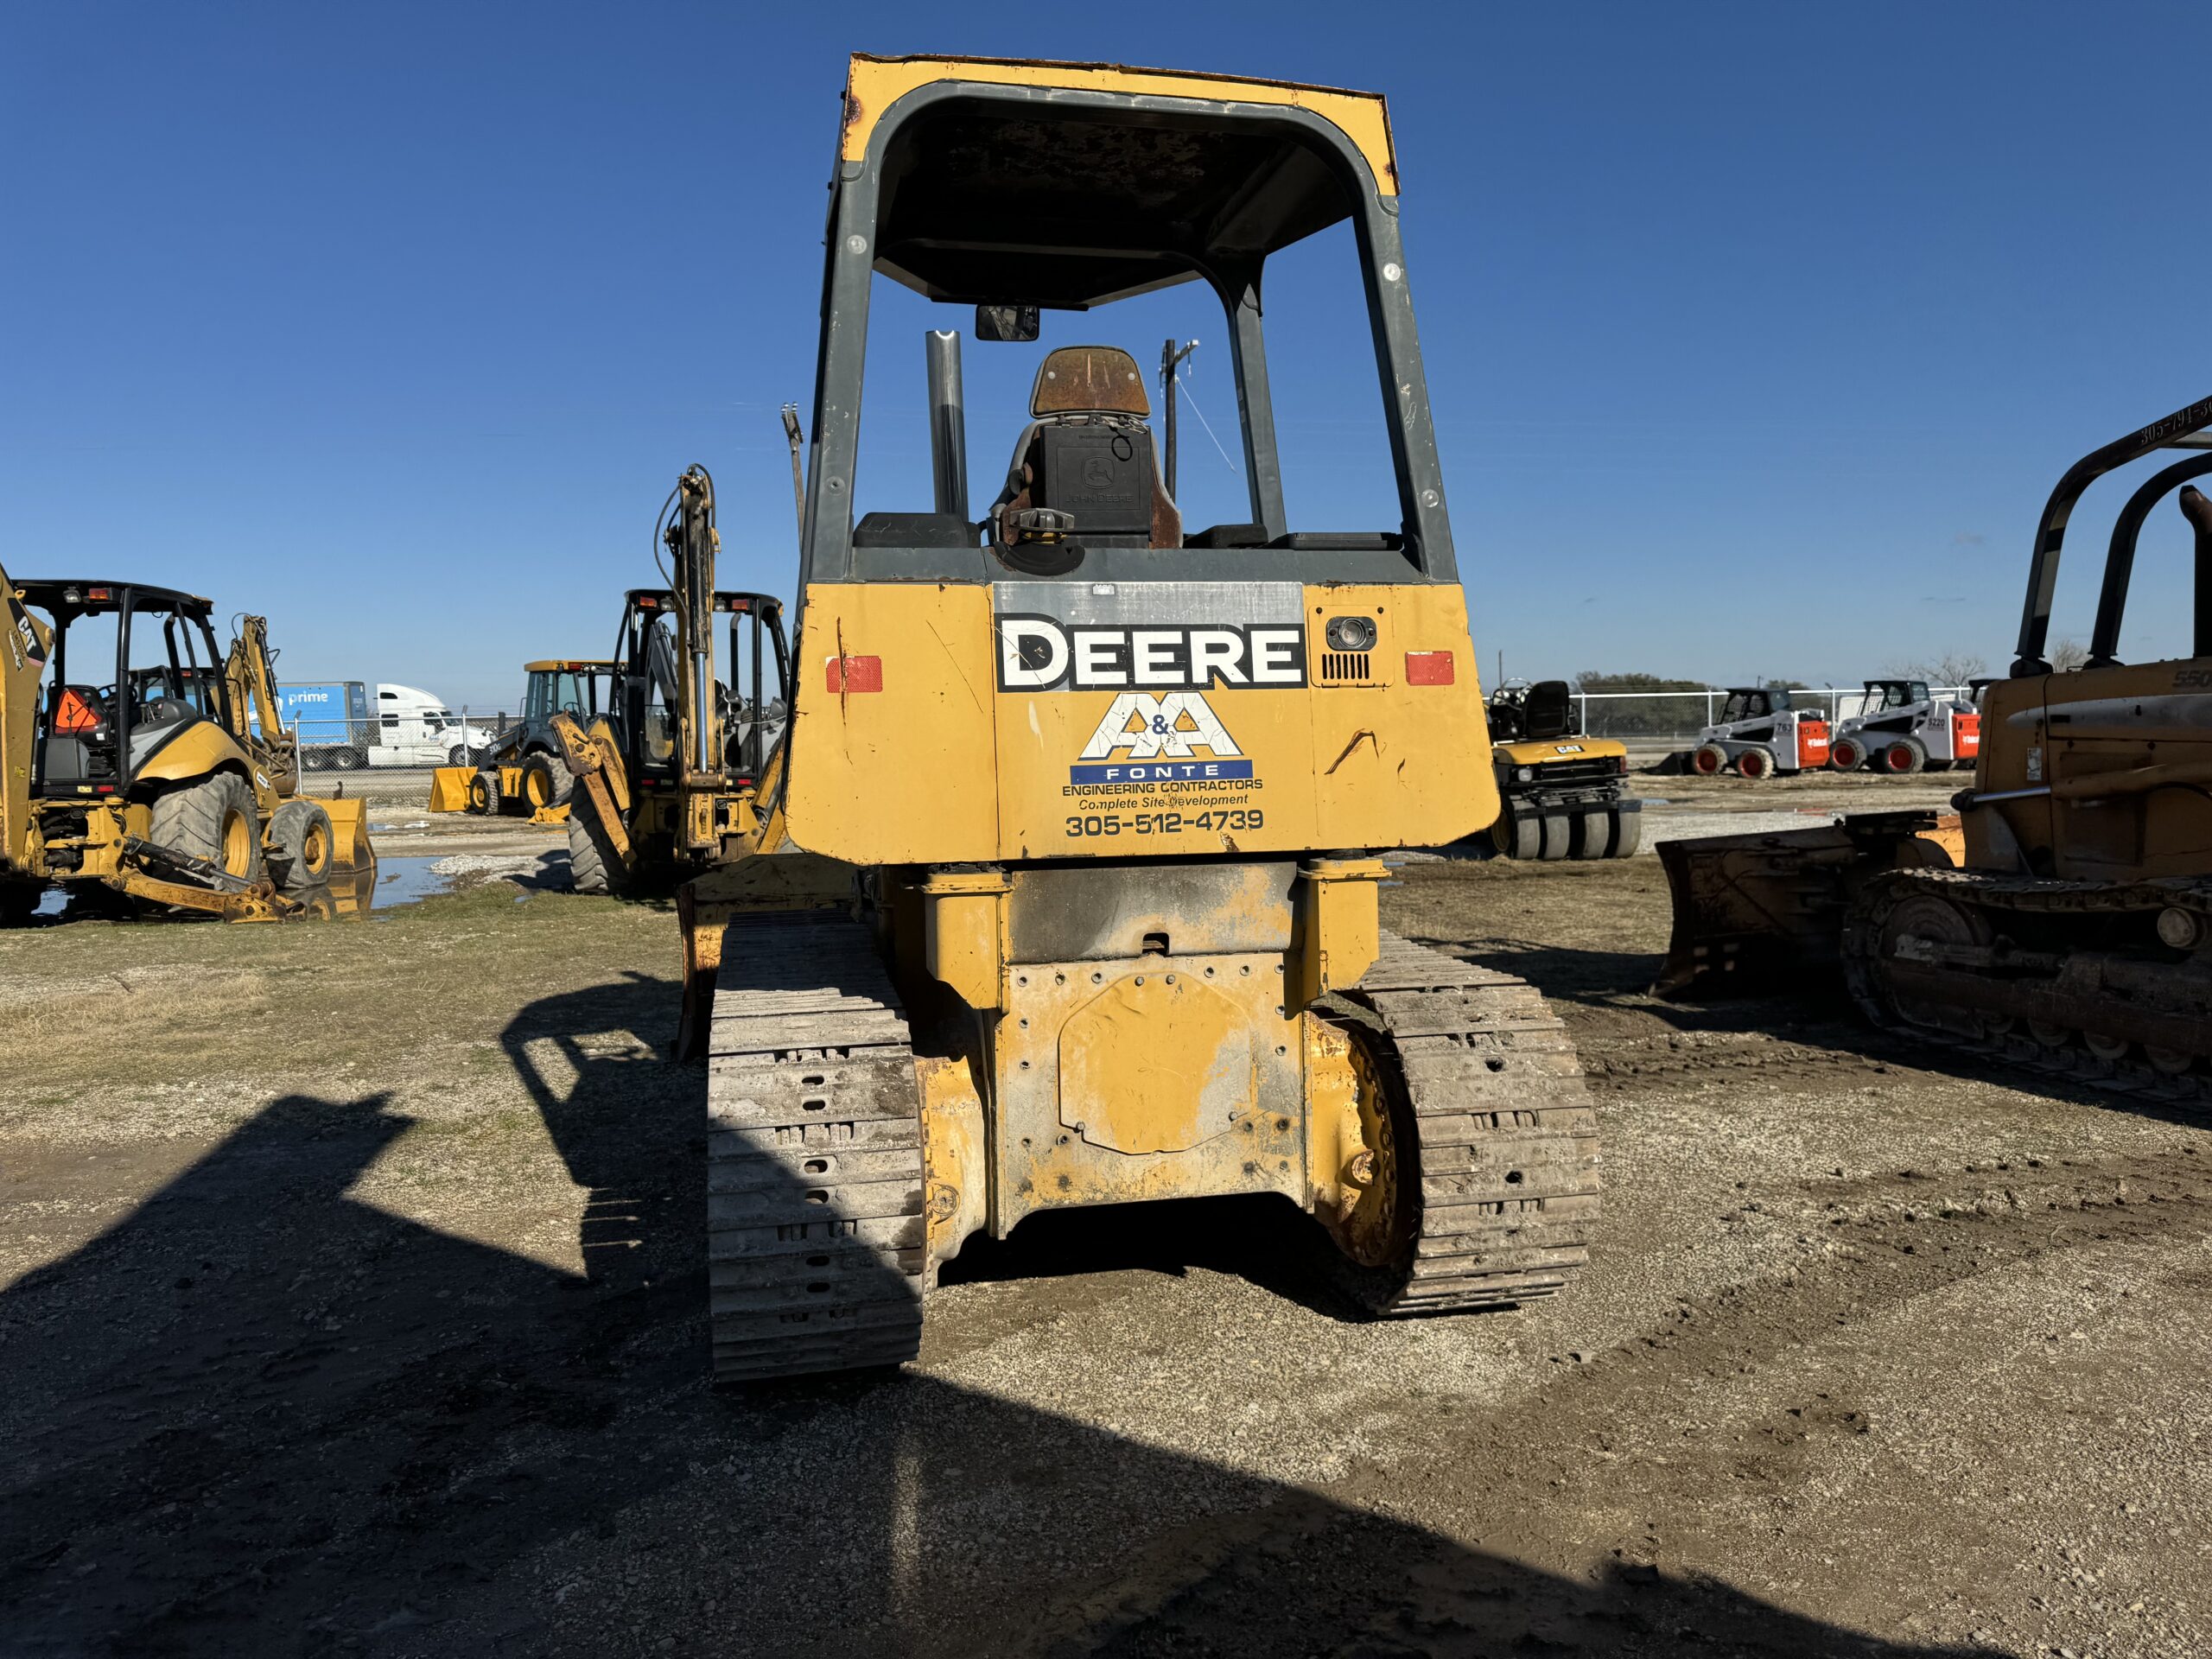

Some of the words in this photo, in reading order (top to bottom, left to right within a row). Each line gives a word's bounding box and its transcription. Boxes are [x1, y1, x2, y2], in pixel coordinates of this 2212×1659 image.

[1097, 493, 1134, 503] DEERE
[17, 615, 37, 652] CAT
[1001, 619, 1302, 686] DEERE
[289, 690, 328, 705] prime
[1077, 691, 1244, 761] A&A
[1777, 722, 1792, 733] 763
[1555, 745, 1583, 753] CAT
[1106, 765, 1219, 779] FONTE
[1062, 783, 1155, 797] ENGINEERING
[1160, 779, 1264, 792] CONTRACTORS
[1079, 798, 1138, 811] Complete
[1141, 797, 1166, 808] Site
[1065, 809, 1264, 836] 305-512-4739
